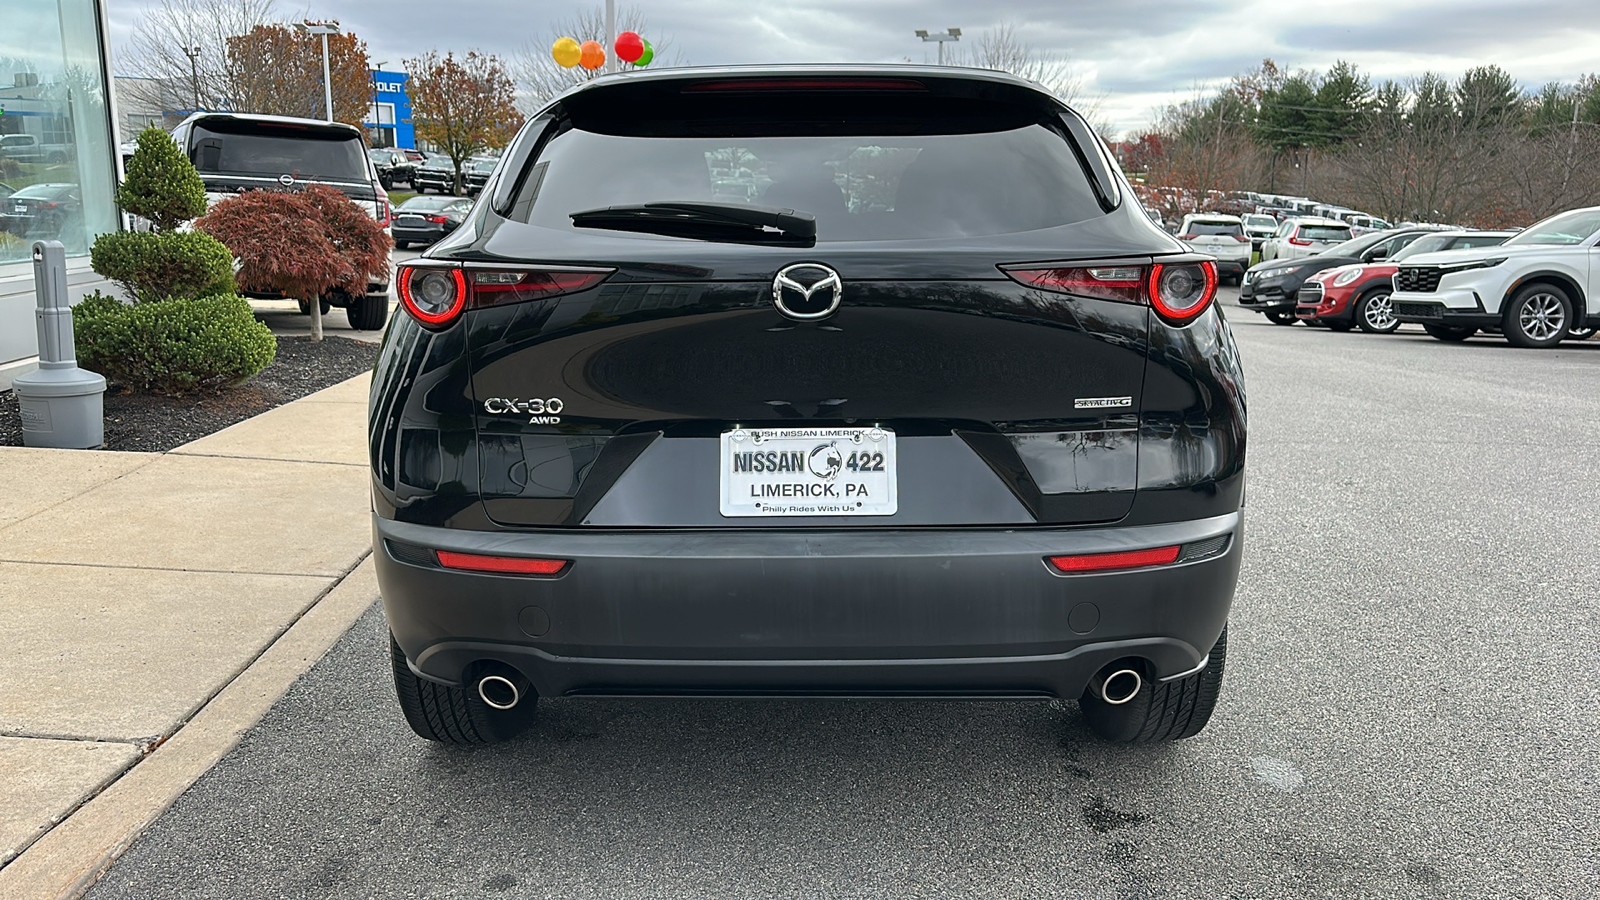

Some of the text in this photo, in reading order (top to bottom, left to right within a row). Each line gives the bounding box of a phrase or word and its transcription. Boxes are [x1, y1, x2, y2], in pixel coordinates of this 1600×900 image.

[484, 397, 564, 414] CX-30
[529, 416, 561, 425] AWD
[751, 430, 778, 438] BUSH
[820, 429, 865, 437] LIMERICK
[734, 452, 885, 473] NISSAN 422
[751, 483, 869, 498] LIMERICK, PA
[762, 505, 787, 514] Philly
[789, 505, 815, 513] Rides
